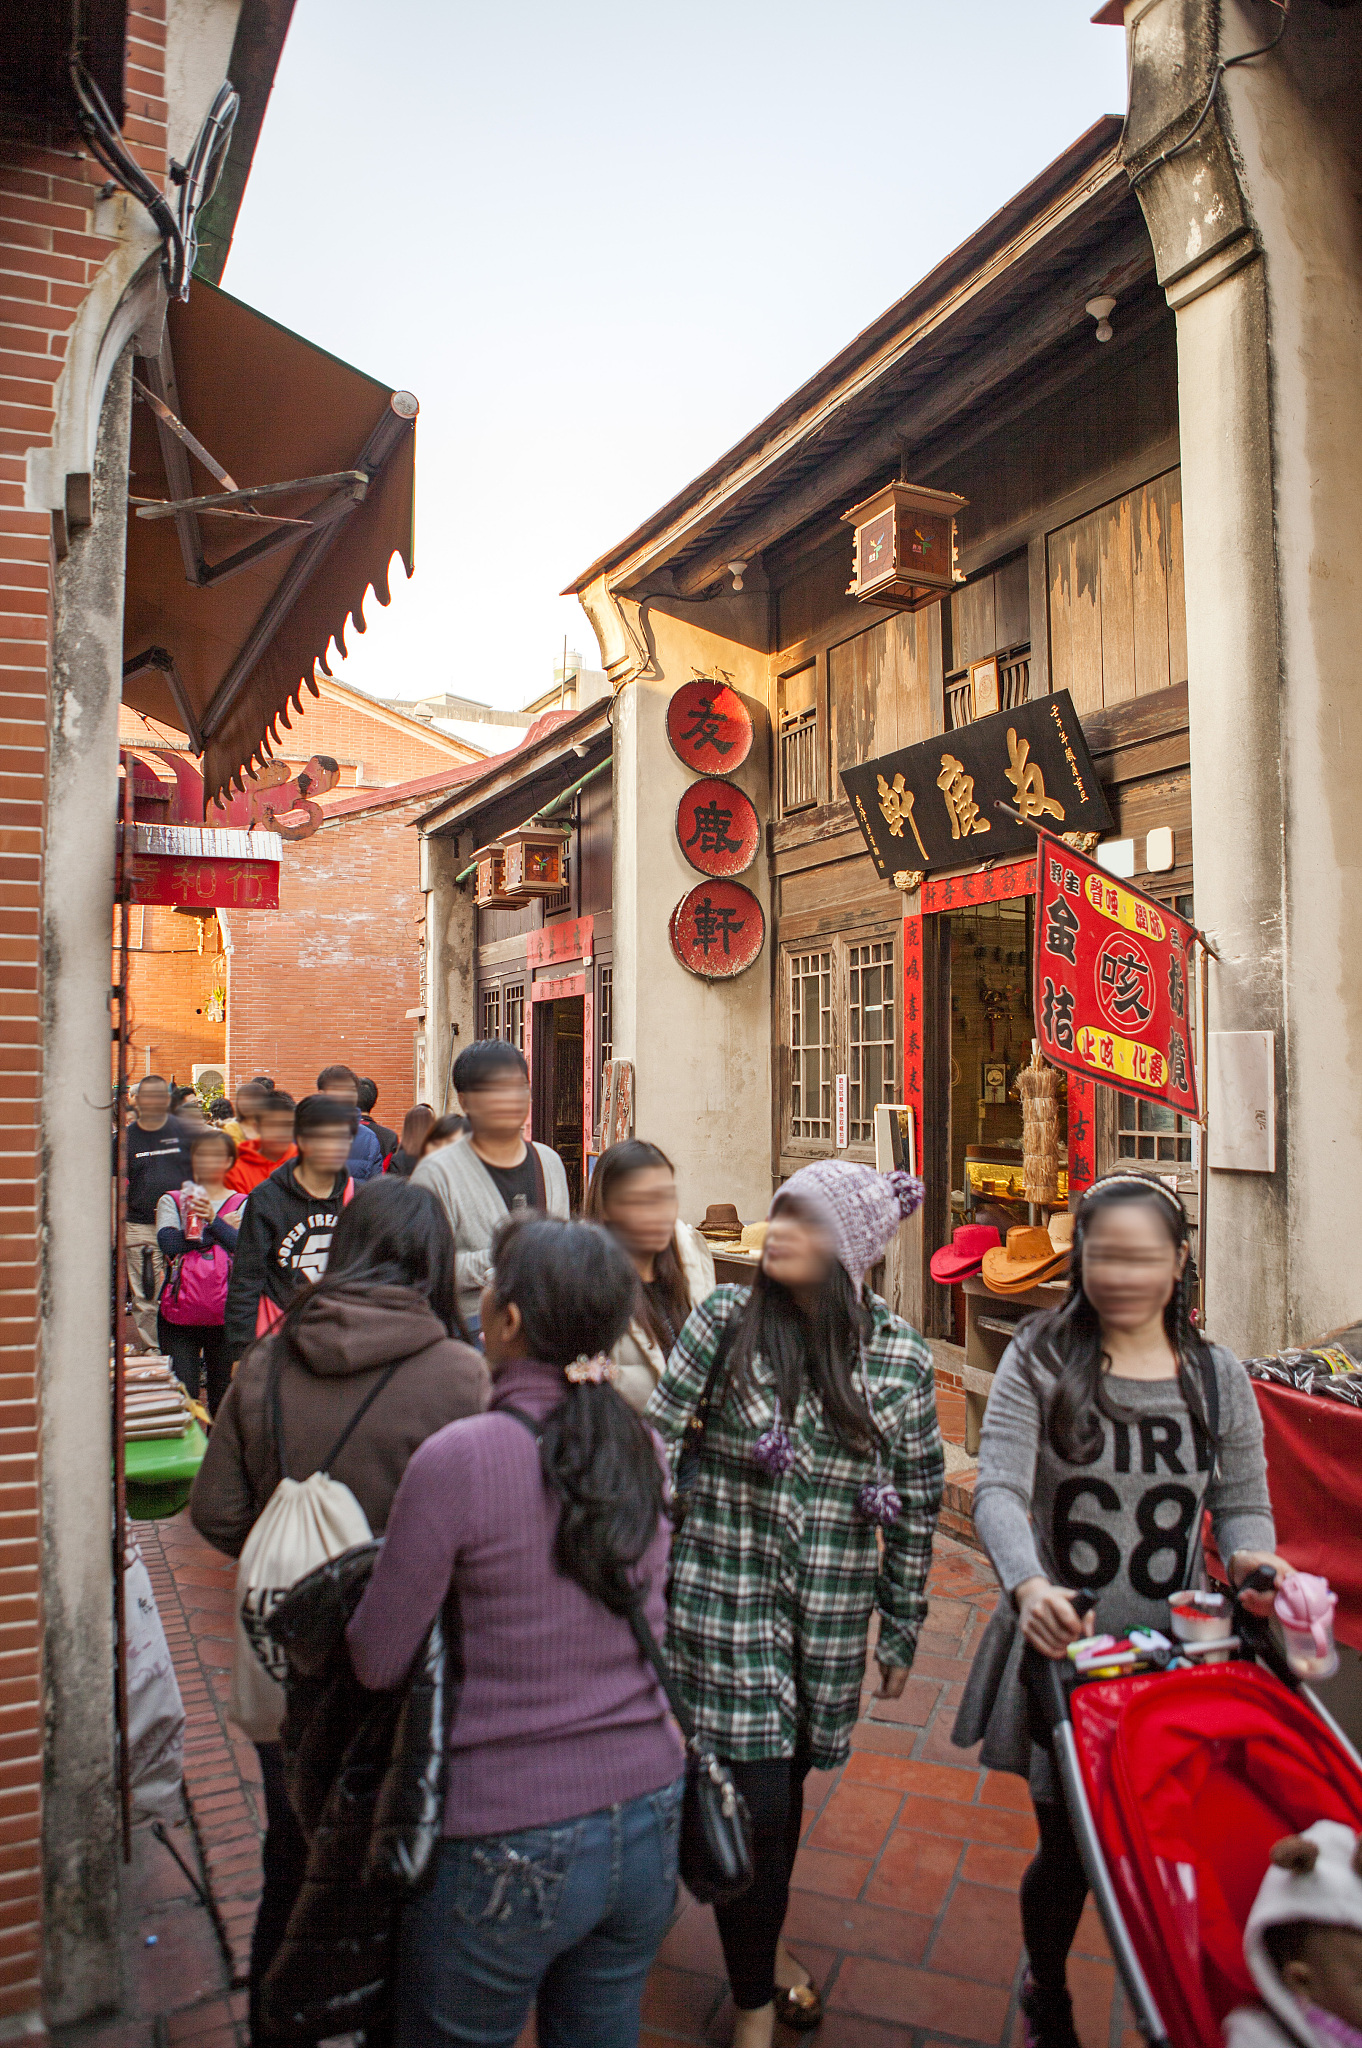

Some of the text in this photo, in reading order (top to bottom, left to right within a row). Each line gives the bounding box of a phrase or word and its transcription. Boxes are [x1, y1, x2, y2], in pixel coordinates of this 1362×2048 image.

[679, 697, 745, 956] 友鹿軒
[877, 727, 1065, 861] 友鹿軒
[1040, 893, 1081, 1053] 金桔
[1101, 952, 1150, 1022] 咳
[1052, 1476, 1199, 1600] 68
